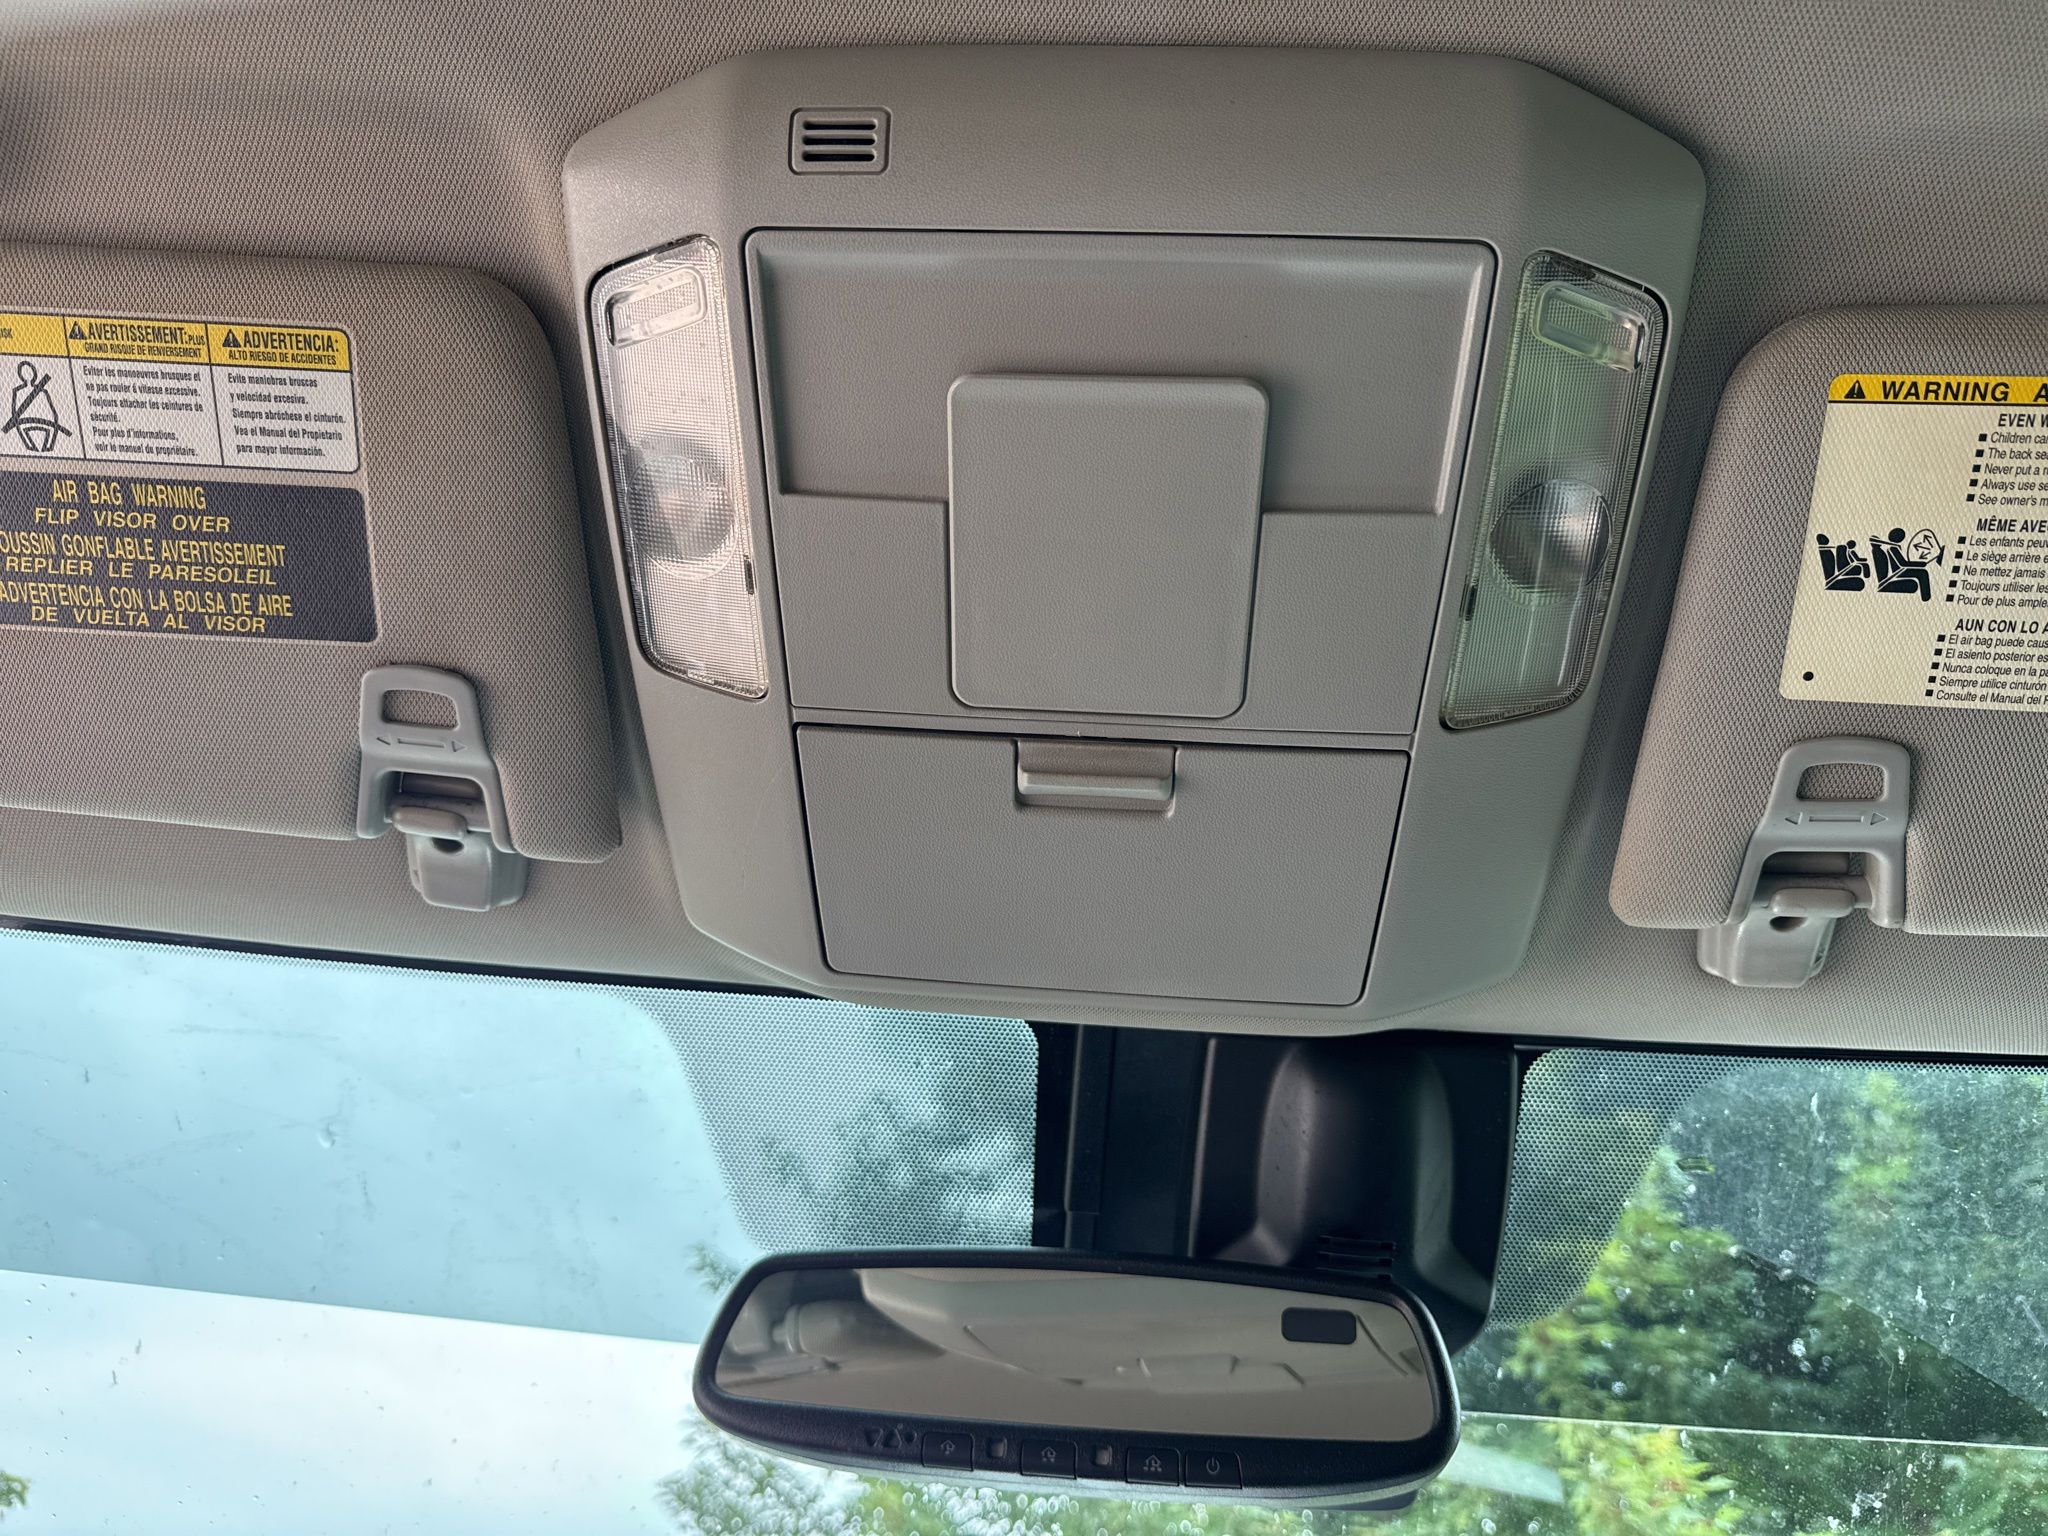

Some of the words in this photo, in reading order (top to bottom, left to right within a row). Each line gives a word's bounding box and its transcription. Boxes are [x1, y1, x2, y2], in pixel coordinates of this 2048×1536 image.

[89, 322, 189, 345] AVERTISSEMENT:
[189, 334, 205, 346] PLUS
[244, 330, 339, 353] ADVERTENCIA:
[85, 342, 108, 353] GRAND
[111, 343, 136, 355] RISQUE
[137, 345, 146, 355] DE
[148, 345, 201, 358] RENVERSEMENT
[228, 350, 247, 361] ALTO
[250, 350, 277, 363] RIESGO
[280, 352, 289, 363] DE
[291, 353, 337, 365] ACCIDENTES
[161, 370, 192, 382] brusques
[228, 373, 246, 384] Evite
[248, 375, 287, 386] maniobras
[289, 376, 318, 388] bruscas
[97, 383, 108, 393] pas
[138, 385, 163, 394] vitesse
[165, 386, 201, 396] excessive.
[1882, 381, 2010, 402] WARNING
[87, 396, 118, 409] Toujours
[120, 398, 147, 409] attacher
[149, 400, 160, 410] les
[161, 401, 193, 411] ceintures
[194, 402, 203, 412] de
[230, 393, 235, 403] y
[237, 392, 271, 403] velocidad
[274, 394, 309, 405] excesiva.
[232, 408, 263, 420] Siempre
[305, 412, 311, 421] el
[1998, 413, 2036, 428] EVEN
[92, 426, 108, 437] Pour
[110, 428, 125, 439] plus
[234, 425, 249, 436] Vea
[251, 426, 257, 436] el
[260, 426, 287, 438] Manual
[288, 428, 300, 438] del
[302, 429, 343, 441] Propietario
[1990, 431, 2031, 444] Children
[95, 443, 108, 452] voir
[110, 443, 117, 452] le
[119, 444, 143, 454] manuel
[145, 445, 154, 454] du
[236, 444, 252, 454] para
[255, 445, 277, 456] mayor
[1988, 447, 2006, 460] The
[2009, 448, 2032, 460] back
[1984, 463, 2014, 475] Never
[2015, 465, 2032, 477] put
[2033, 466, 2040, 476] a
[1980, 478, 2016, 493] Always
[2017, 481, 2036, 491] use
[53, 480, 79, 503] AIR
[87, 481, 122, 506] BAG
[131, 483, 207, 510] WARNING
[1978, 493, 1998, 505] See
[2000, 495, 2037, 506] owner's
[35, 507, 79, 525] FLIP
[93, 510, 157, 529] VISOR
[172, 514, 230, 533] OVER
[1976, 515, 2017, 532] MÊME
[1969, 535, 1987, 546] Les
[1990, 536, 2024, 548] enfants
[61, 533, 156, 561] GONFLABLE
[161, 540, 286, 567] AVERTISSEMENT
[1966, 550, 1978, 561] Le
[1980, 550, 2007, 565] siège
[2009, 552, 2041, 563] arrière
[5, 556, 93, 576] REPLIER
[108, 561, 133, 578] LE
[149, 563, 277, 585] PARESOLEIL
[1963, 565, 1977, 576] Ne
[1979, 566, 2012, 578] mettez
[2012, 567, 2046, 580] jamais
[1960, 579, 2000, 593] Toujours
[2002, 581, 2035, 592] utiliser
[0, 580, 106, 607] ADVERTENCIA
[110, 586, 143, 610] CON
[149, 589, 169, 611] LA
[173, 589, 227, 614] BOLSA
[231, 592, 253, 615] DE
[258, 593, 294, 617] AIRE
[1957, 594, 1980, 606] Pour
[1981, 595, 1994, 606] de
[1995, 596, 2016, 608] plus
[31, 605, 59, 622] DE
[73, 607, 150, 626] VUELTA
[163, 612, 189, 629] AL
[204, 614, 266, 632] VISOR
[1955, 618, 1984, 631] AUN
[1988, 619, 2017, 633] CON
[2020, 620, 2039, 634] LO
[1948, 634, 1959, 645] El
[1960, 635, 1973, 645] air
[1975, 635, 1993, 649] bag
[1994, 637, 2025, 649] puede
[1945, 648, 1955, 659] El
[1957, 649, 1992, 660] asiento
[1992, 651, 2035, 663] posterior
[1942, 662, 1973, 674] Nunca
[1974, 664, 2011, 677] coloque
[2014, 667, 2026, 676] en
[2028, 666, 2037, 677] la
[1939, 676, 1978, 690] Siempre
[1980, 678, 2007, 689] utilice
[2009, 679, 2047, 691] cinturón
[1936, 689, 1977, 702] Consulte
[1979, 692, 1989, 702] el
[1990, 692, 2025, 704] Manual
[2026, 694, 2042, 705] del
